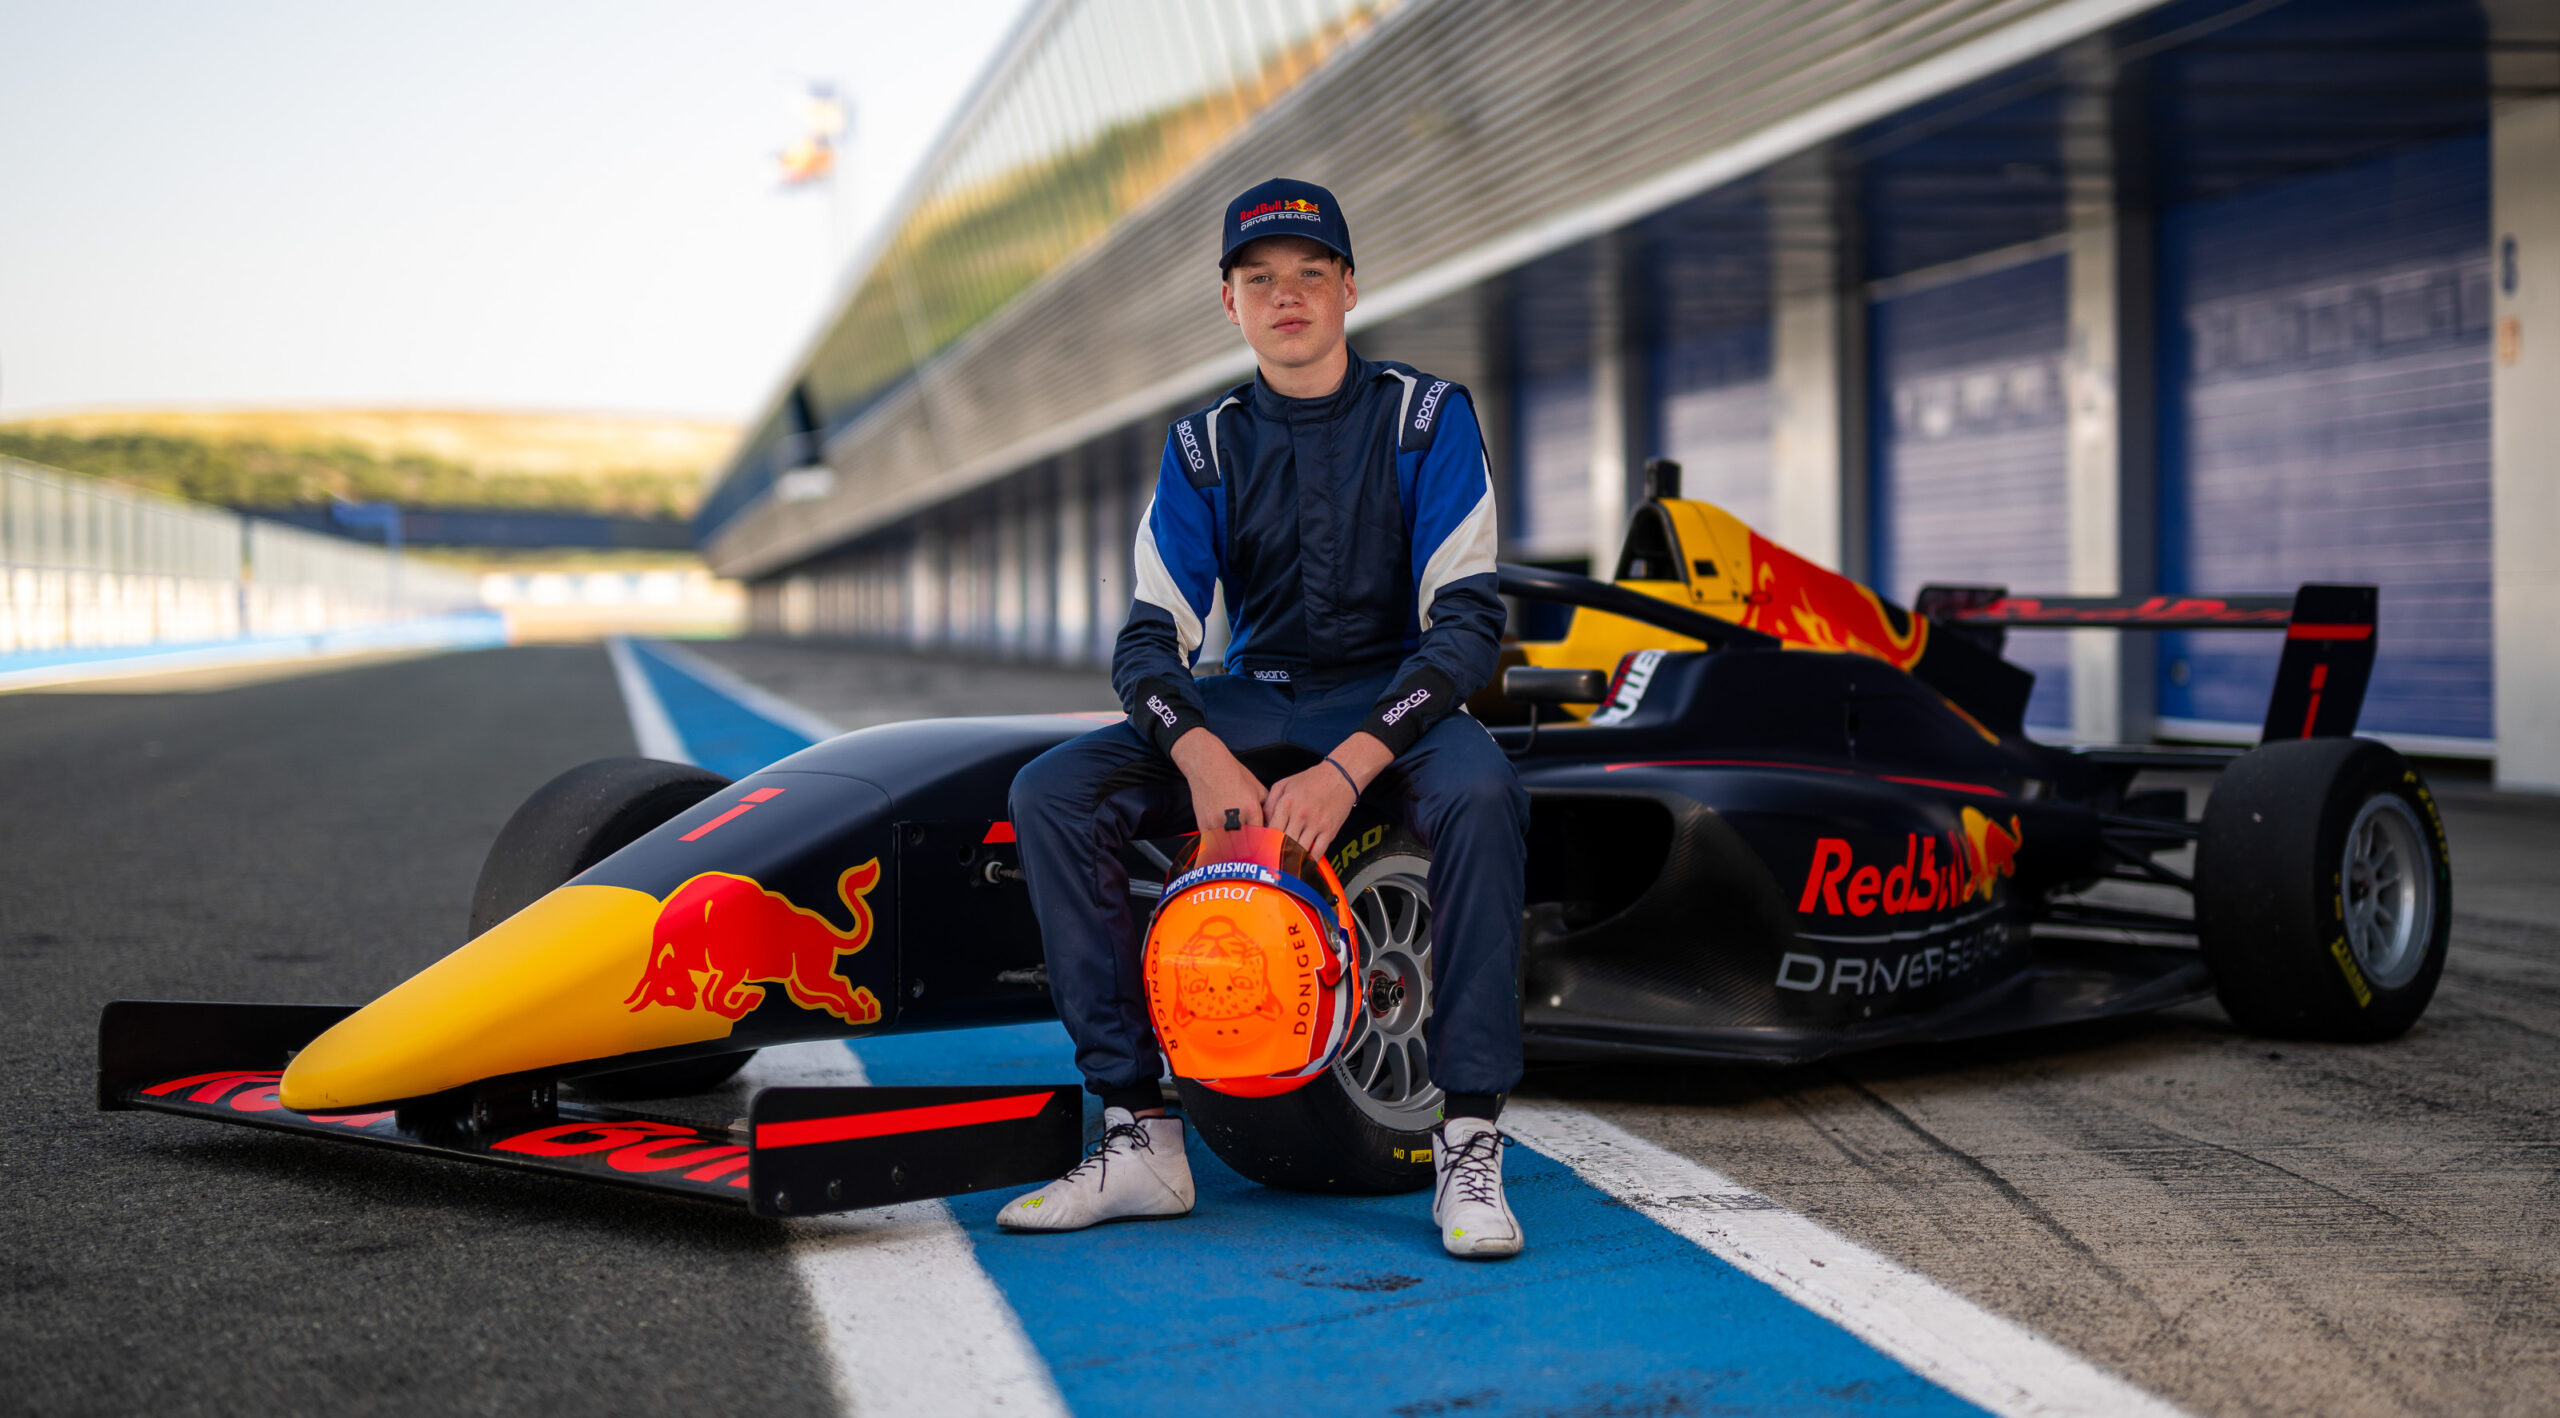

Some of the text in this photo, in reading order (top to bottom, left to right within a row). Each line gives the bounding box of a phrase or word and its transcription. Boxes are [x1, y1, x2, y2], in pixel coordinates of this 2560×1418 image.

[1240, 213, 1321, 231] DRIVER SEARCH
[1414, 381, 1451, 432] sparco
[1176, 420, 1205, 472] sparco
[1253, 670, 1291, 682] sparc
[1146, 695, 1178, 728] sprco
[1382, 689, 1431, 726] sparco
[1206, 861, 1259, 877] DIJKSTRA
[1151, 940, 1179, 1051] DONIGER
[1288, 923, 1312, 1036] DONIGER
